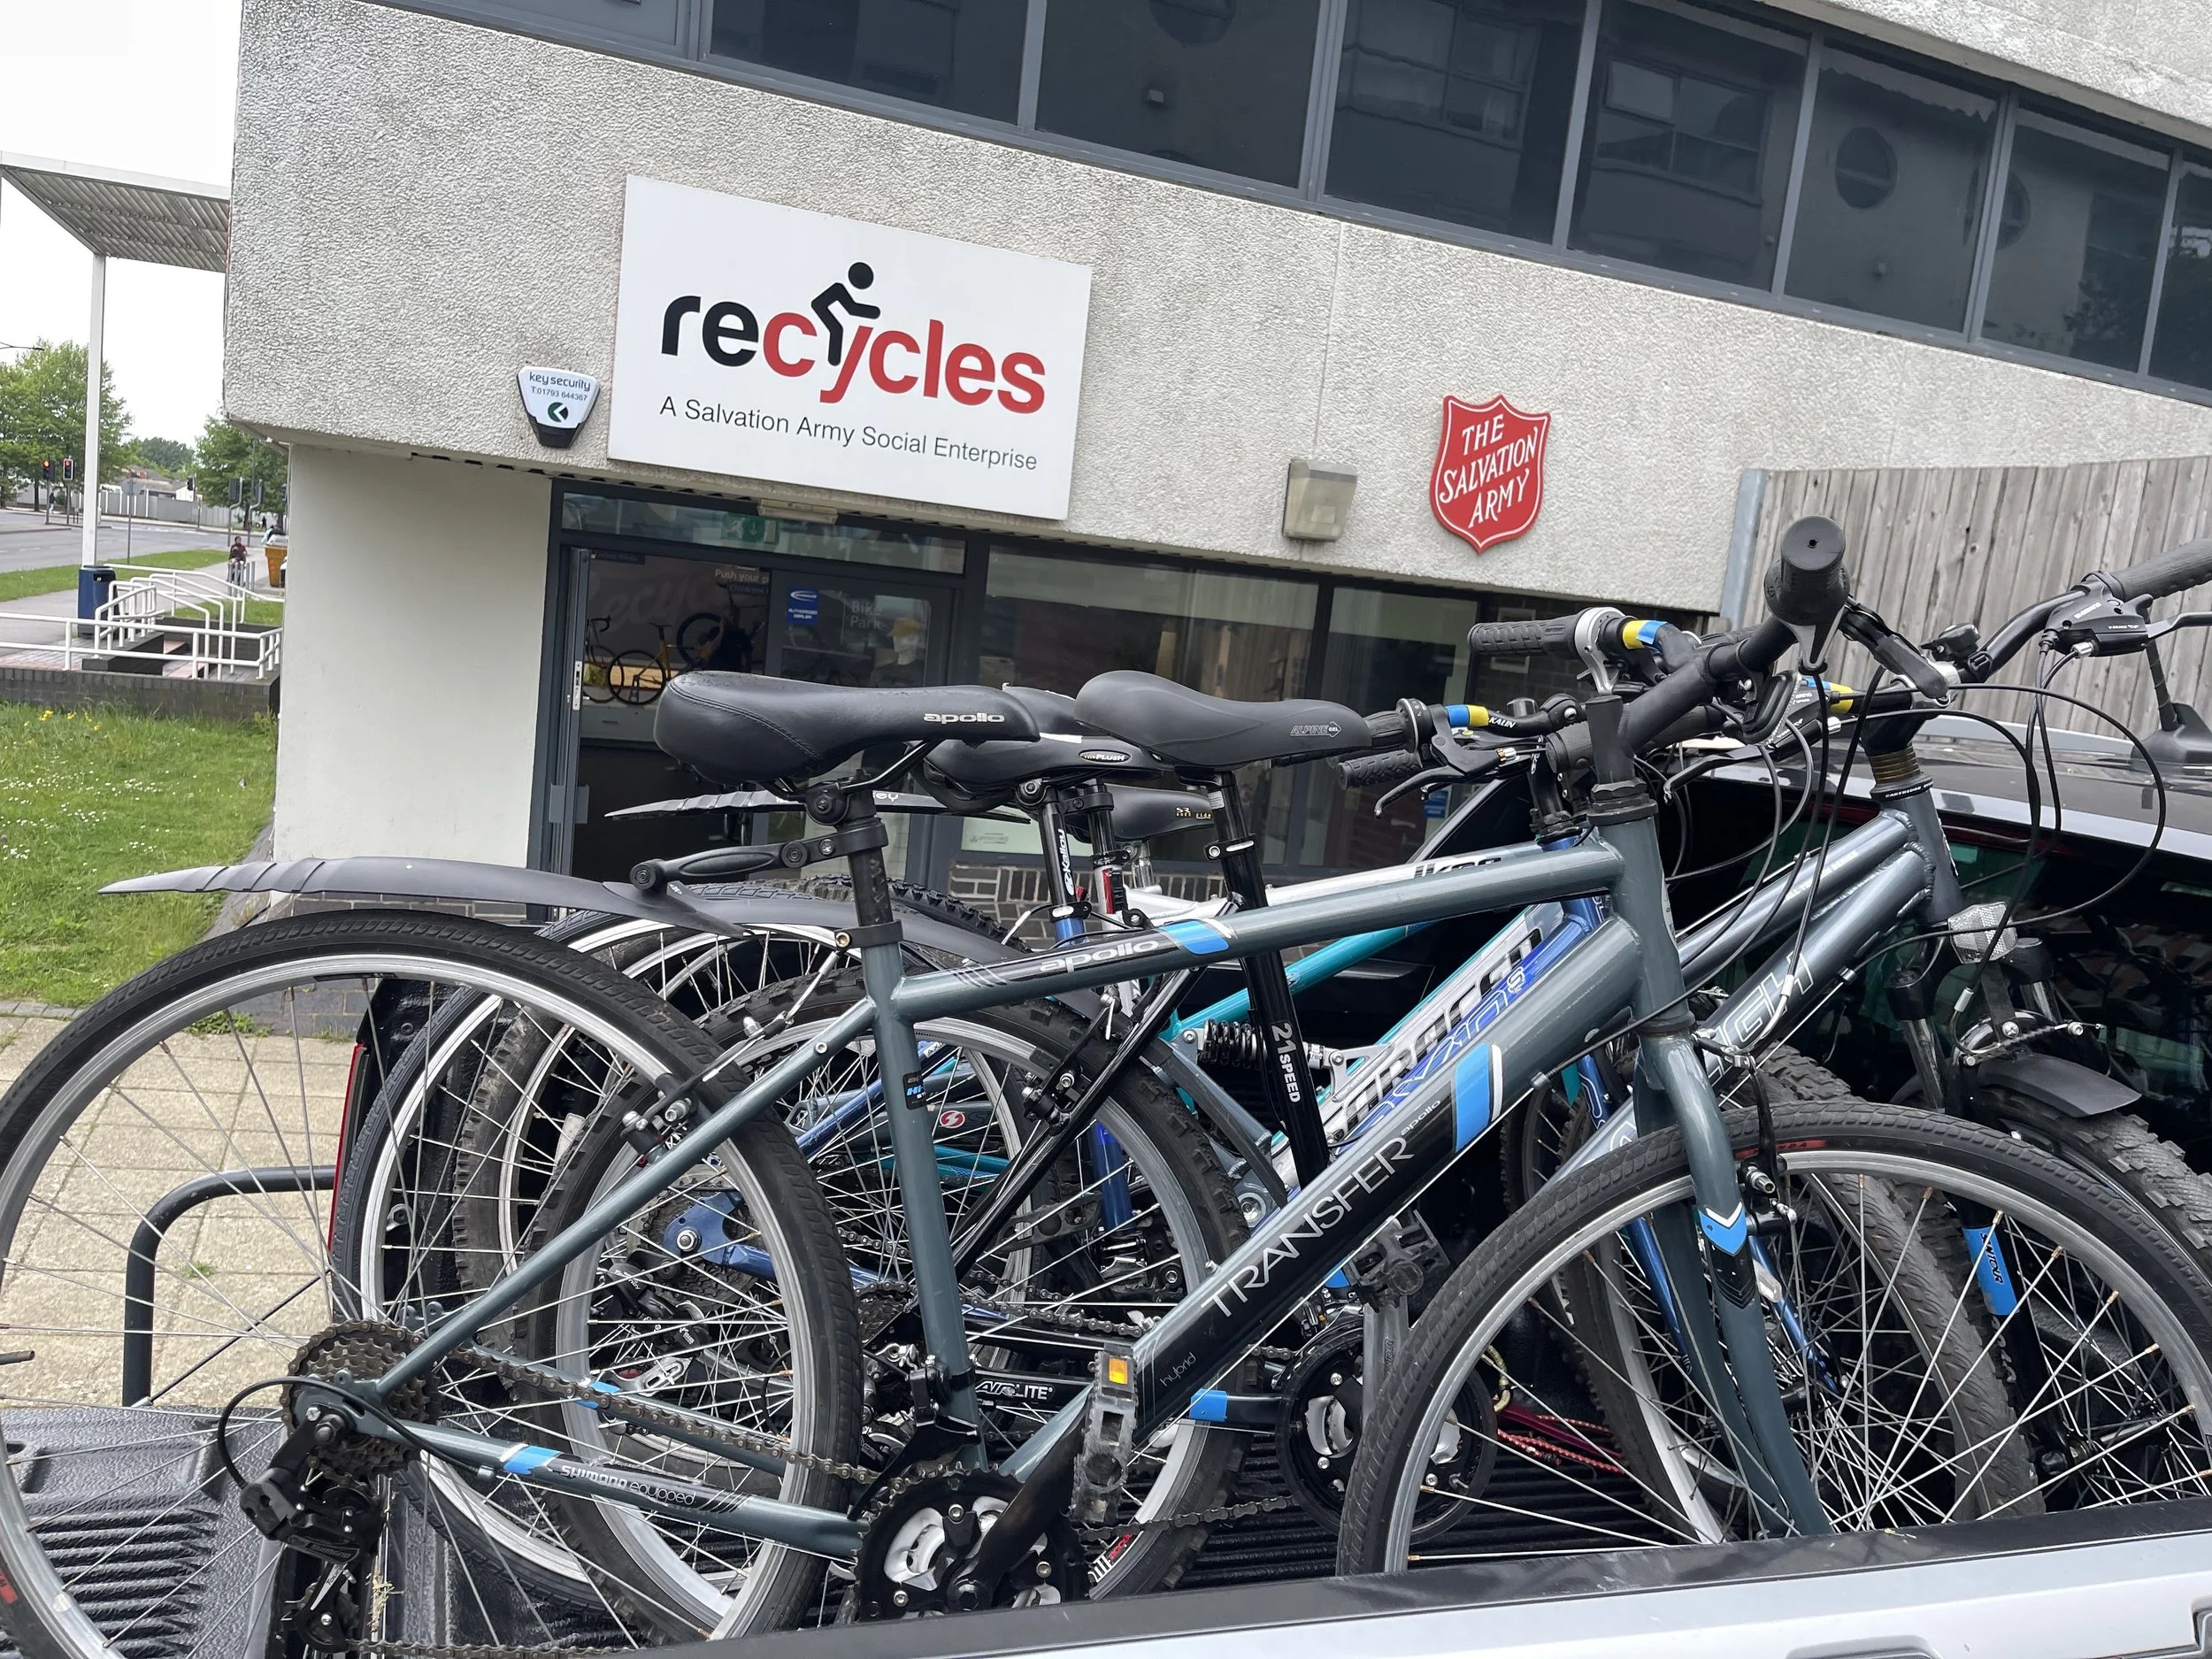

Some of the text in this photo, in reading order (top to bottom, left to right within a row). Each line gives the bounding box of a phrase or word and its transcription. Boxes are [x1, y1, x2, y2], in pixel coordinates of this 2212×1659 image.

[661, 295, 1046, 415] recycles
[529, 371, 591, 392] key security
[659, 395, 1038, 471] A Salvation Army Social Enterprise
[1462, 413, 1505, 457] THE
[1439, 426, 1539, 504] SALVATION
[1467, 467, 1530, 529] ARMY
[923, 712, 1005, 725] apollo
[1290, 725, 1328, 737] ALPINE
[1488, 716, 1517, 729] KALIN
[1040, 940, 1159, 973] apollo
[1271, 1022, 1302, 1103] 21 SPEED
[1401, 1099, 1441, 1136] apollo
[1200, 1137, 1416, 1318] TRANSFER
[1159, 1352, 1197, 1387] hybrid
[629, 1481, 698, 1506] equipped
